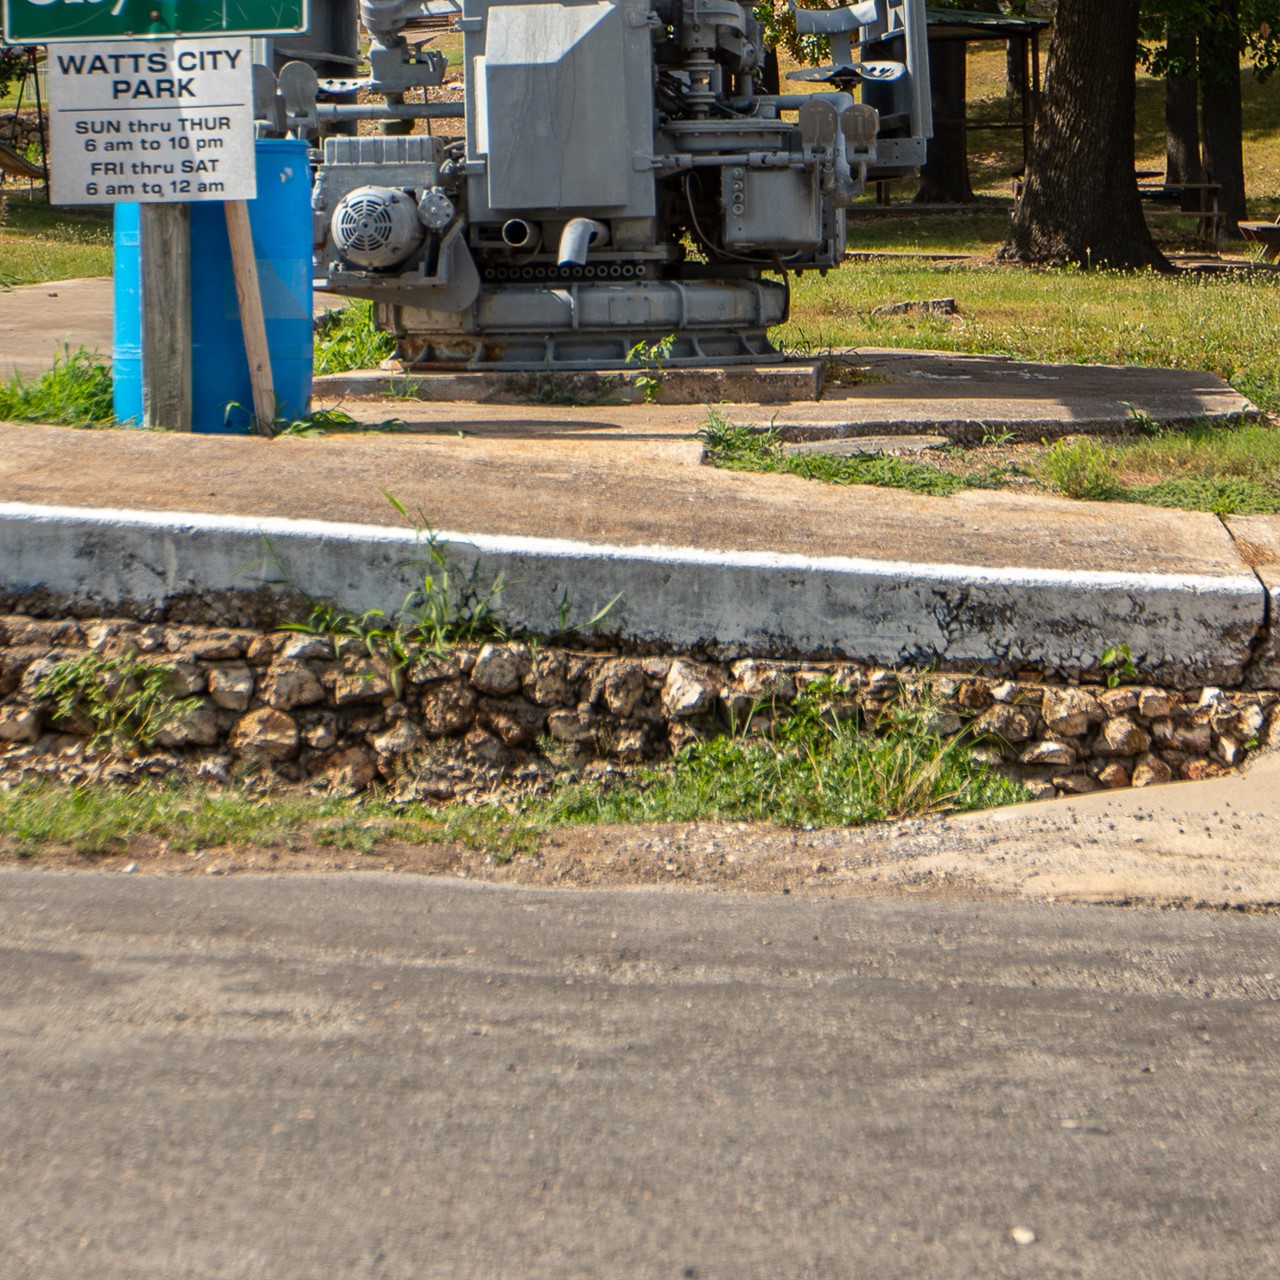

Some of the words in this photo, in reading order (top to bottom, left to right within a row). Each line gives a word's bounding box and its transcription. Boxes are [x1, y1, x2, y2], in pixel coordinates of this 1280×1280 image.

[57, 52, 168, 75] WATTS
[177, 49, 242, 71] CITY
[112, 77, 196, 99] PARK
[75, 120, 120, 134] SUN
[128, 119, 171, 133] thru
[178, 117, 231, 131] THUR
[84, 138, 97, 152] 6
[104, 140, 133, 151] am
[140, 138, 161, 151] to
[169, 136, 190, 150] 10
[196, 137, 223, 152] pm
[91, 162, 124, 176] FRI
[131, 161, 174, 174] thru
[181, 159, 219, 173] SAT
[86, 182, 98, 196] 6
[105, 183, 134, 195] am
[142, 182, 162, 194] to
[170, 179, 191, 193] 12
[197, 181, 224, 193] am
